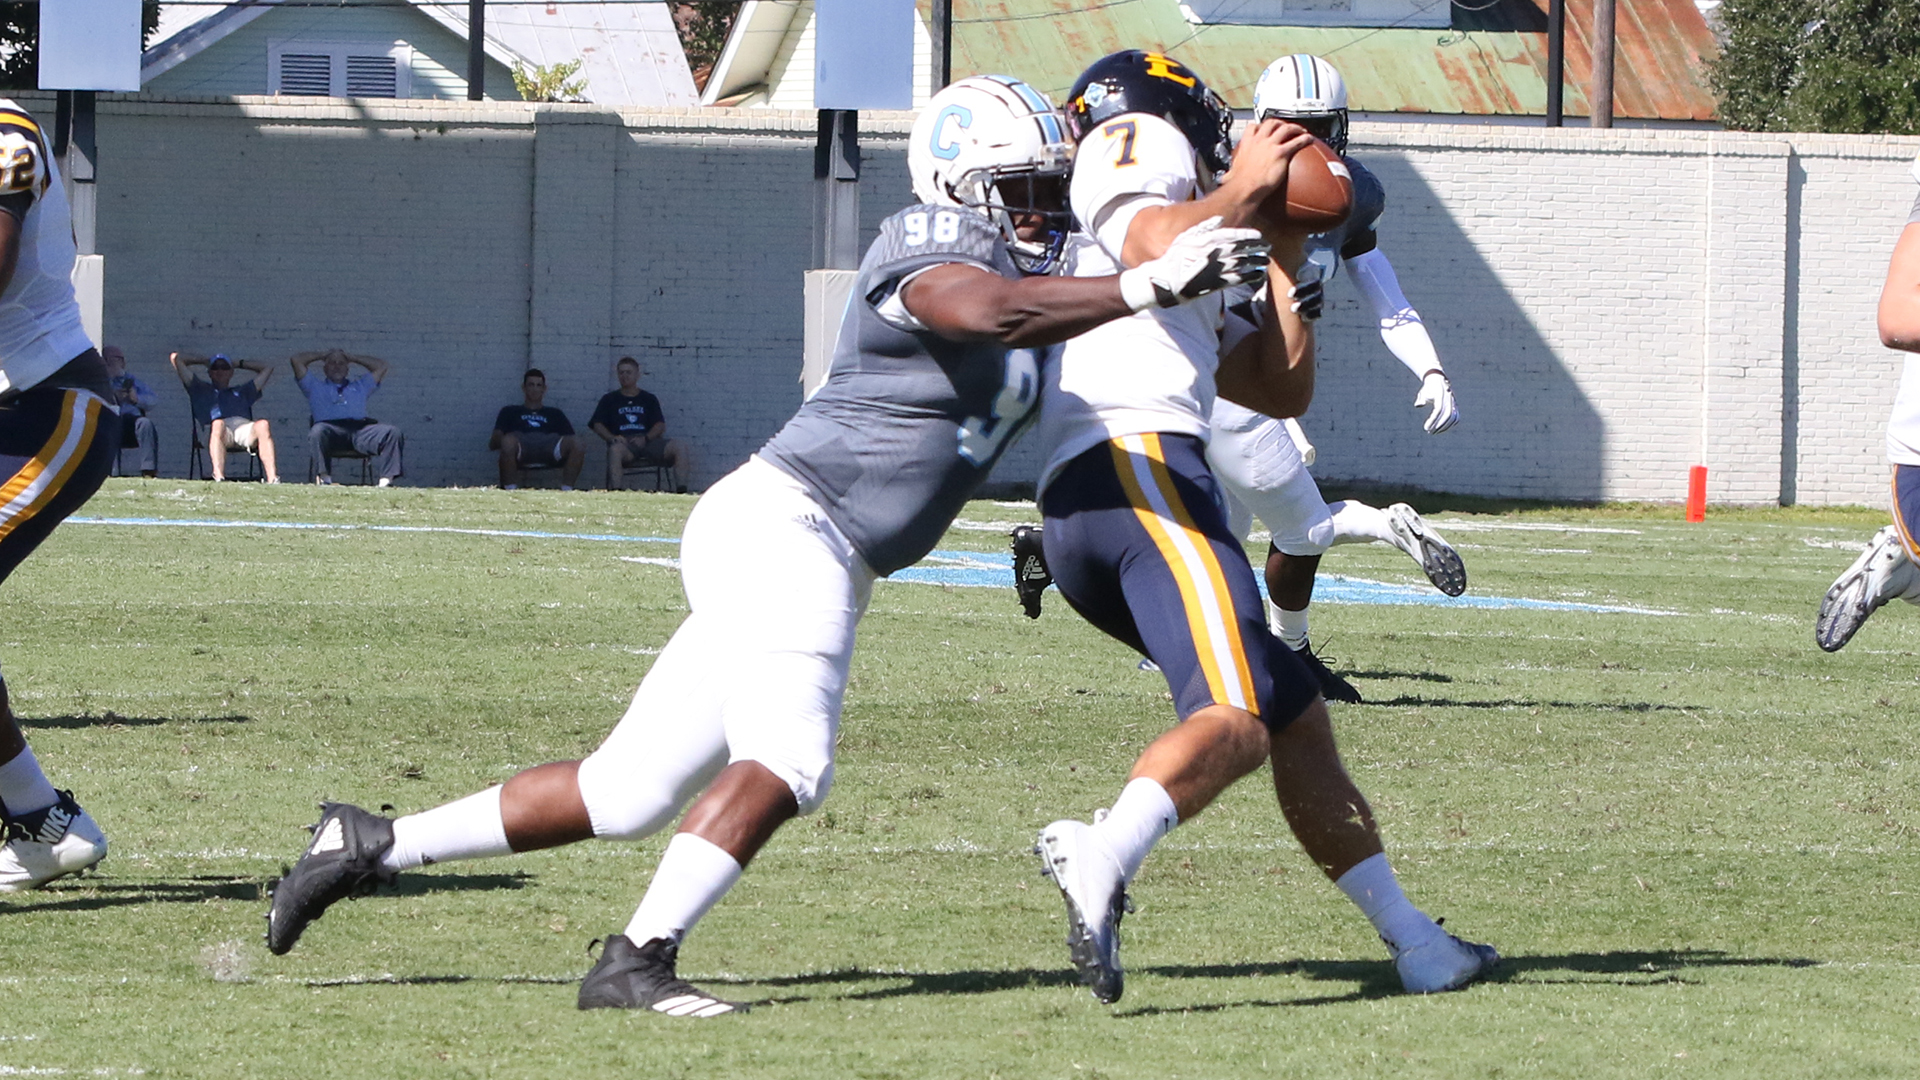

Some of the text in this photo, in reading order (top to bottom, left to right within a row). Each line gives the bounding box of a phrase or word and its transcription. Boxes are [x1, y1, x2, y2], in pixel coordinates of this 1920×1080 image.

[929, 104, 973, 161] C
[1103, 118, 1138, 169] 7
[904, 211, 960, 247] 98
[36, 806, 72, 842] NIKE
